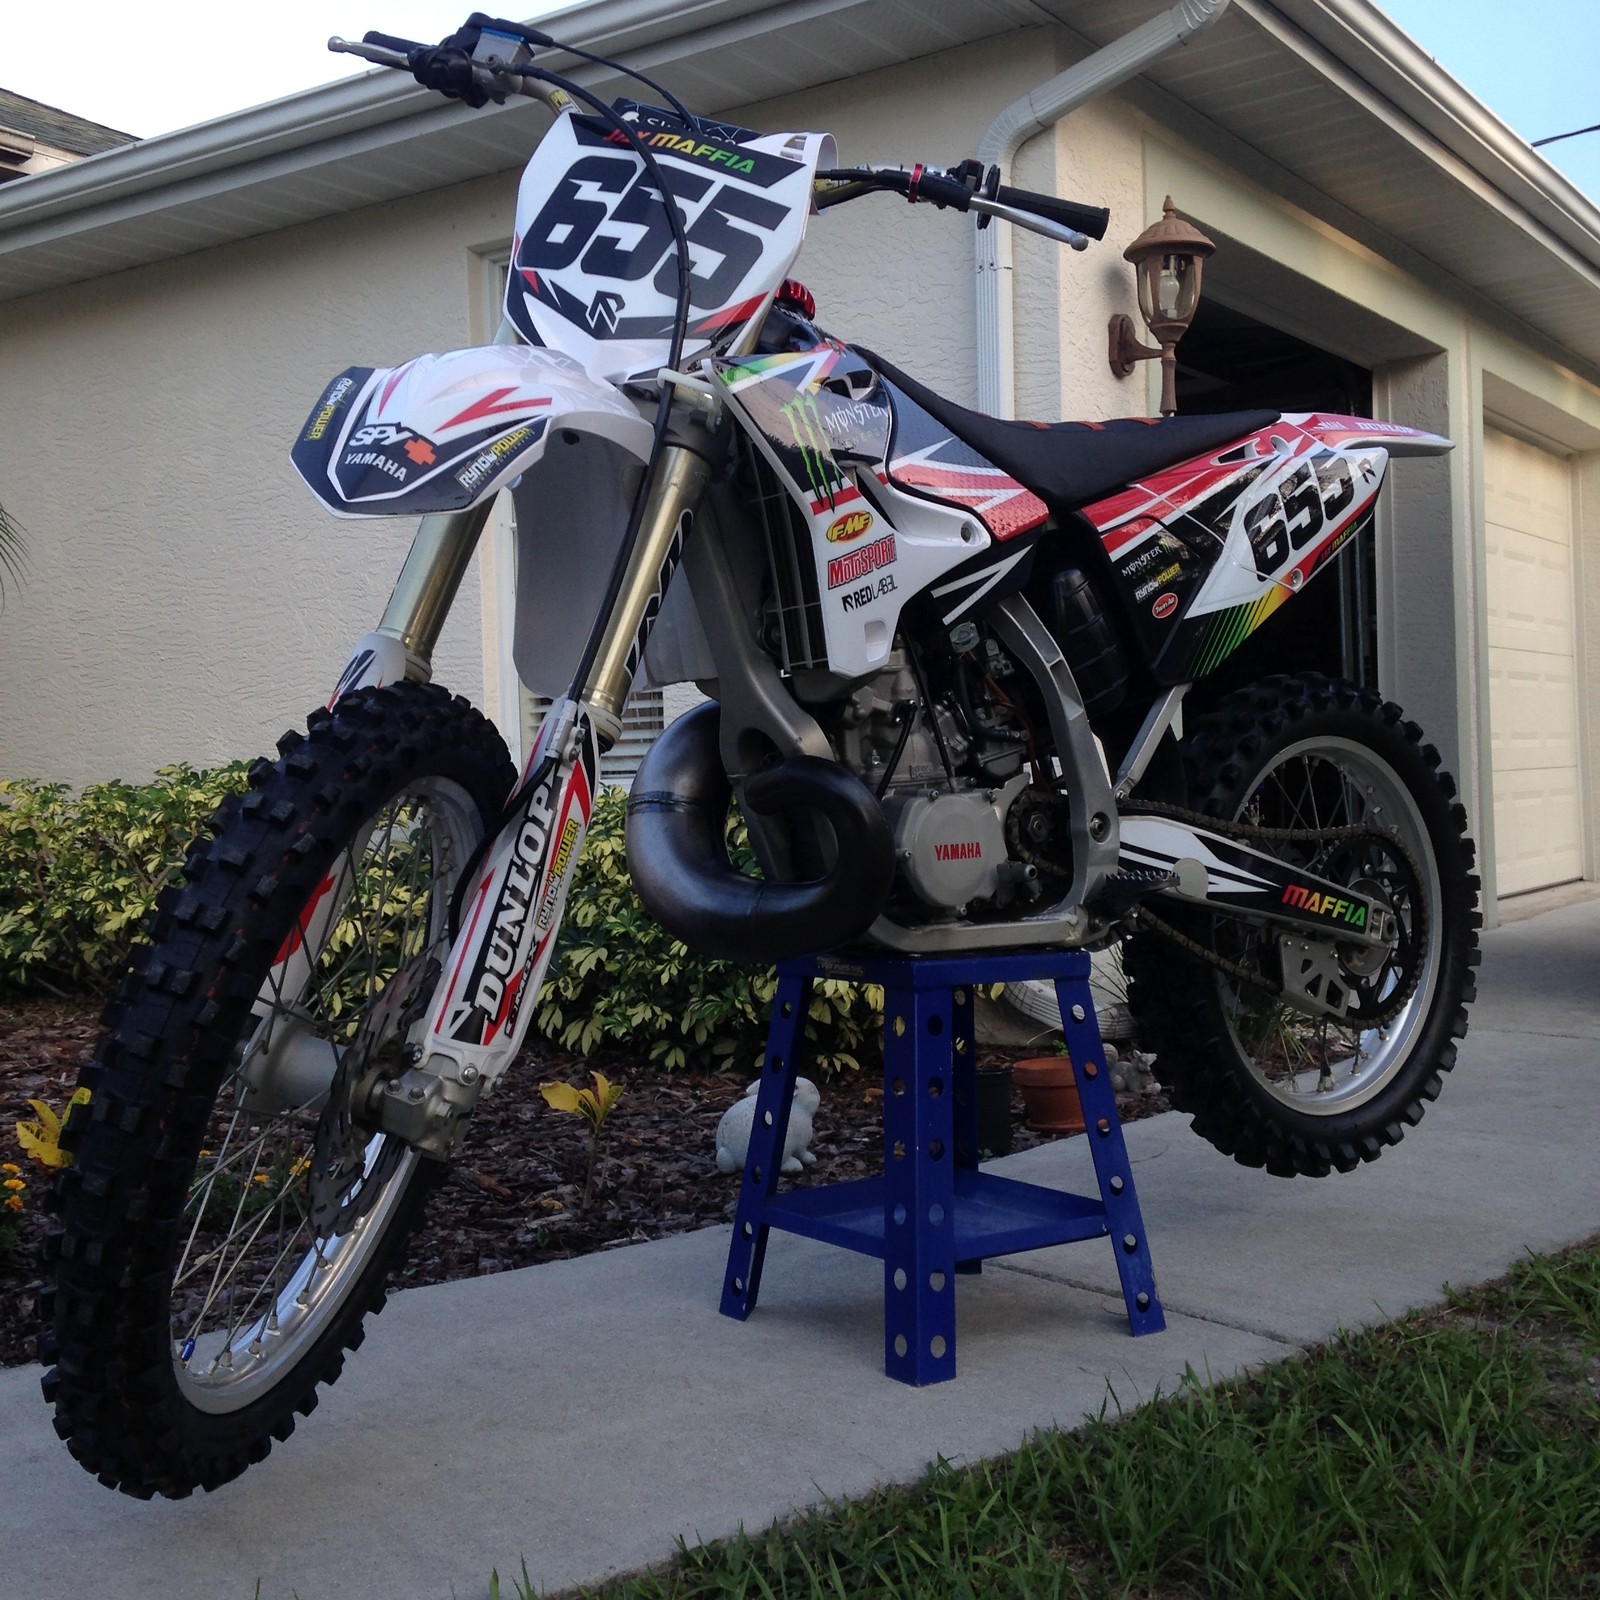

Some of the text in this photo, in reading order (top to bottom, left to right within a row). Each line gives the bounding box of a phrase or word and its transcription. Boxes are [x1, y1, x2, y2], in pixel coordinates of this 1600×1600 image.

[648, 132, 755, 174] MAFFIA
[515, 155, 792, 311] 655
[349, 424, 414, 447] SPY
[344, 453, 408, 482] YAMAHA
[827, 511, 873, 542] FMF
[828, 533, 897, 590] MOTOSPORT
[934, 842, 982, 861] YAMAHA
[474, 782, 556, 1026] DUNLOP
[1281, 884, 1369, 927] MAFFIA
